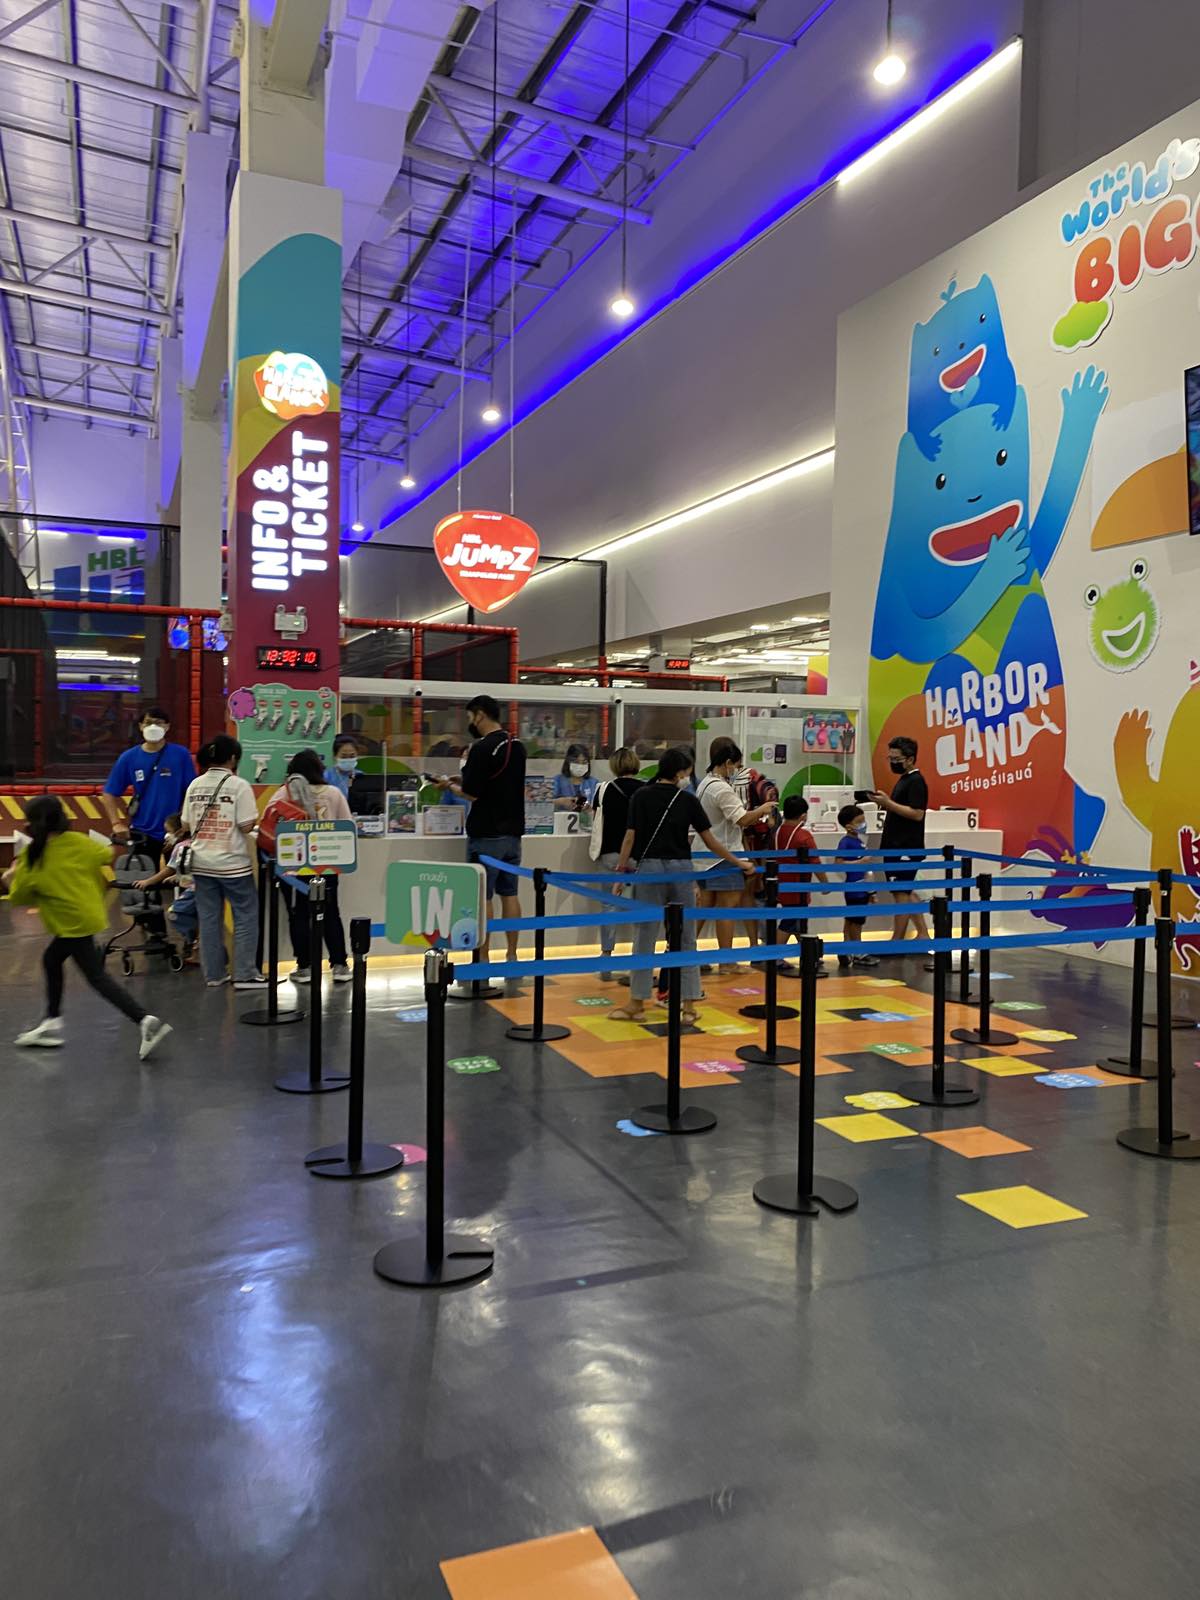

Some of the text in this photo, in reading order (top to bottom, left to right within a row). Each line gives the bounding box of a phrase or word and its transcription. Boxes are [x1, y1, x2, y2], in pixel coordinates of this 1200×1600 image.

[1089, 165, 1127, 198] The
[1074, 199, 1200, 304] BIG
[292, 431, 328, 577] TICKET
[252, 465, 289, 591] INFO &
[88, 546, 145, 572] HBL
[925, 661, 1050, 728] HARBOR
[936, 712, 1062, 776] LAND
[295, 822, 335, 831] FAST LANE
[567, 814, 578, 834] 2
[876, 812, 885, 829] 5
[967, 812, 977, 828] 6
[411, 886, 453, 939] IN
